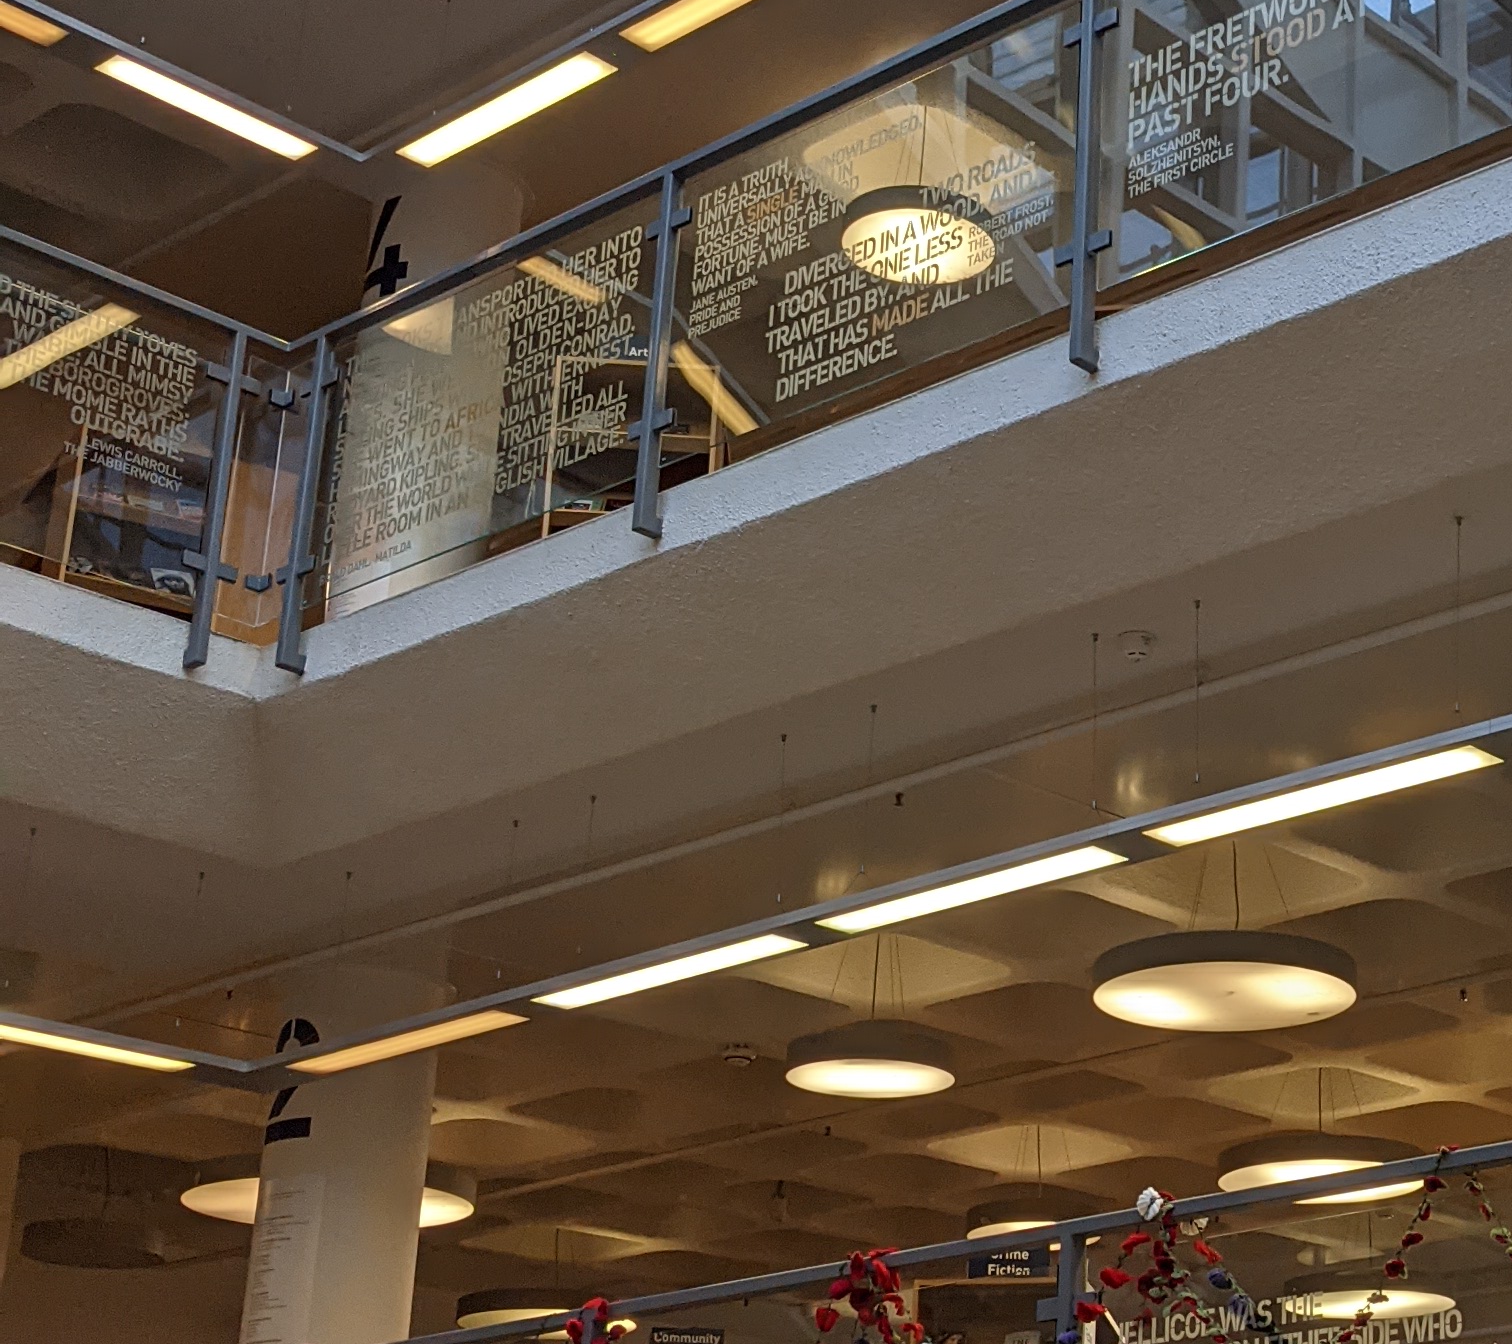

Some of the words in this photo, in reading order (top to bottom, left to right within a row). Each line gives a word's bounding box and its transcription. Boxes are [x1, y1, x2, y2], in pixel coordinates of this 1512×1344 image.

[1128, 51, 1223, 119] HANDS
[1229, 6, 1326, 74] STOOD
[1128, 39, 1182, 89] THE
[1127, 94, 1198, 151] PAST
[1204, 53, 1288, 117] FOUR.
[1127, 127, 1201, 169] ALEKSANDR
[698, 191, 712, 213] IT
[714, 184, 727, 205] IS
[727, 178, 740, 199] A
[740, 155, 789, 193] TRUTH
[1127, 177, 1151, 199] THE
[1154, 161, 1188, 187] FIRST
[1190, 142, 1234, 172] CIRCLE
[687, 305, 741, 339] PREJUDICE
[689, 292, 714, 312] JANE
[689, 303, 718, 326] PRIDE
[719, 293, 741, 313] AND
[86, 435, 123, 459] LEWIS
[90, 450, 182, 492] JABBERWOCKY
[987, 1263, 1030, 1274] Fiction
[1403, 1307, 1462, 1343] WHO
